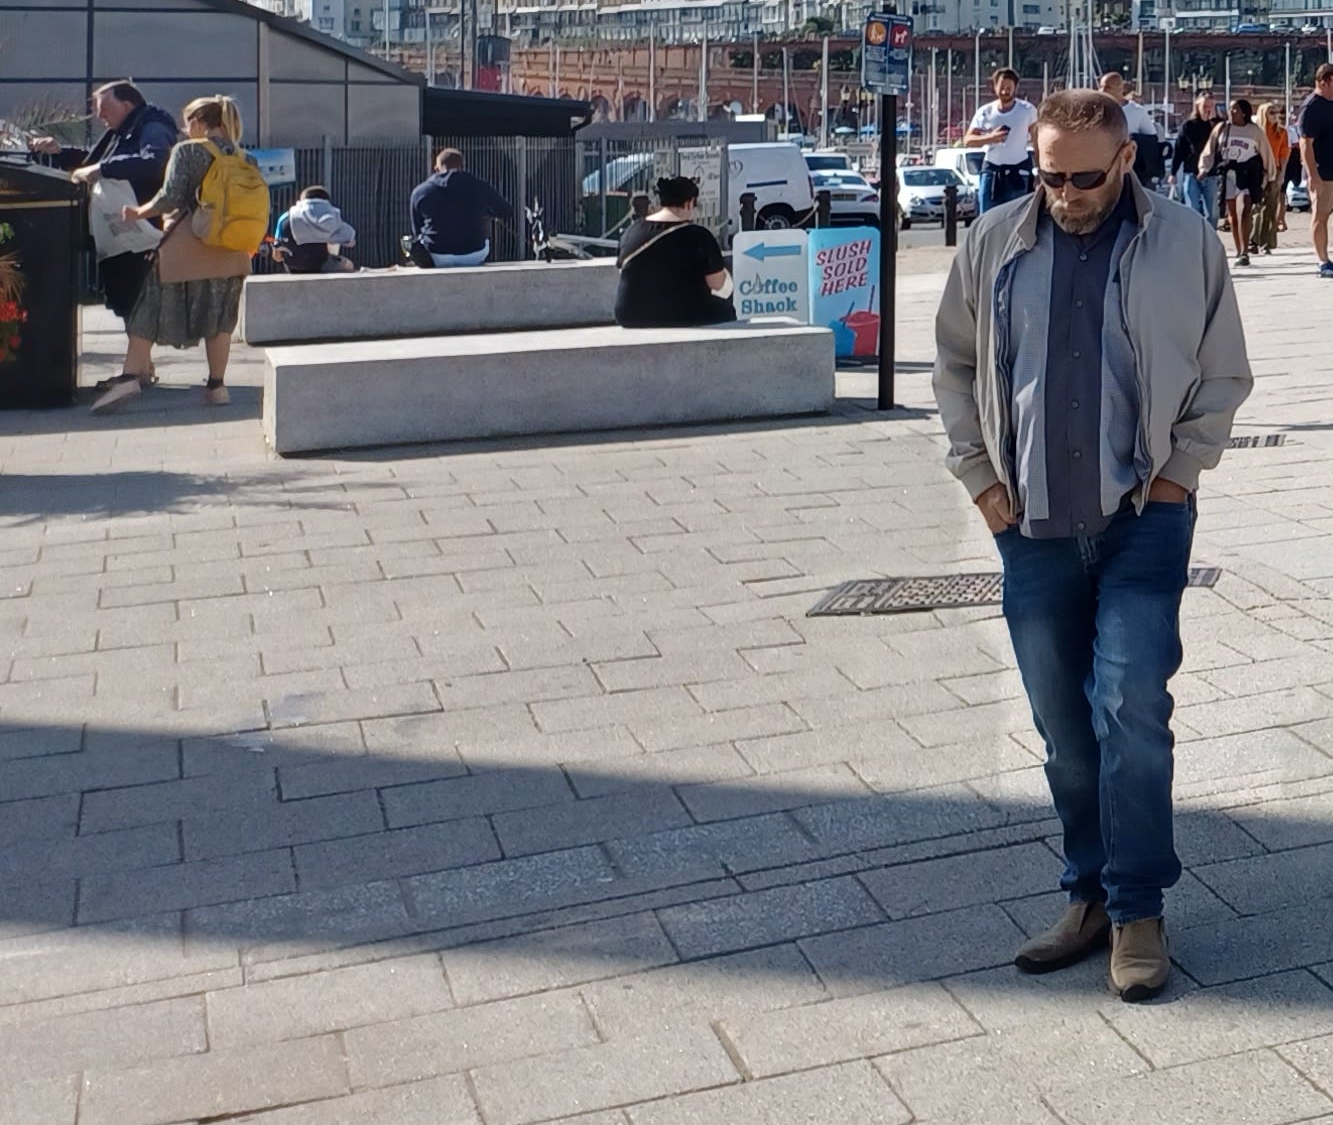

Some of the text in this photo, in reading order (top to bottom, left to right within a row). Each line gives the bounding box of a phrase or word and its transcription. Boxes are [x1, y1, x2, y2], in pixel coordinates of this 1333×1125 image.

[816, 239, 872, 267] SLUSH
[823, 257, 868, 281] SOLD
[739, 276, 798, 296] Coffee
[821, 271, 869, 298] HERE
[741, 296, 799, 315] Shack
